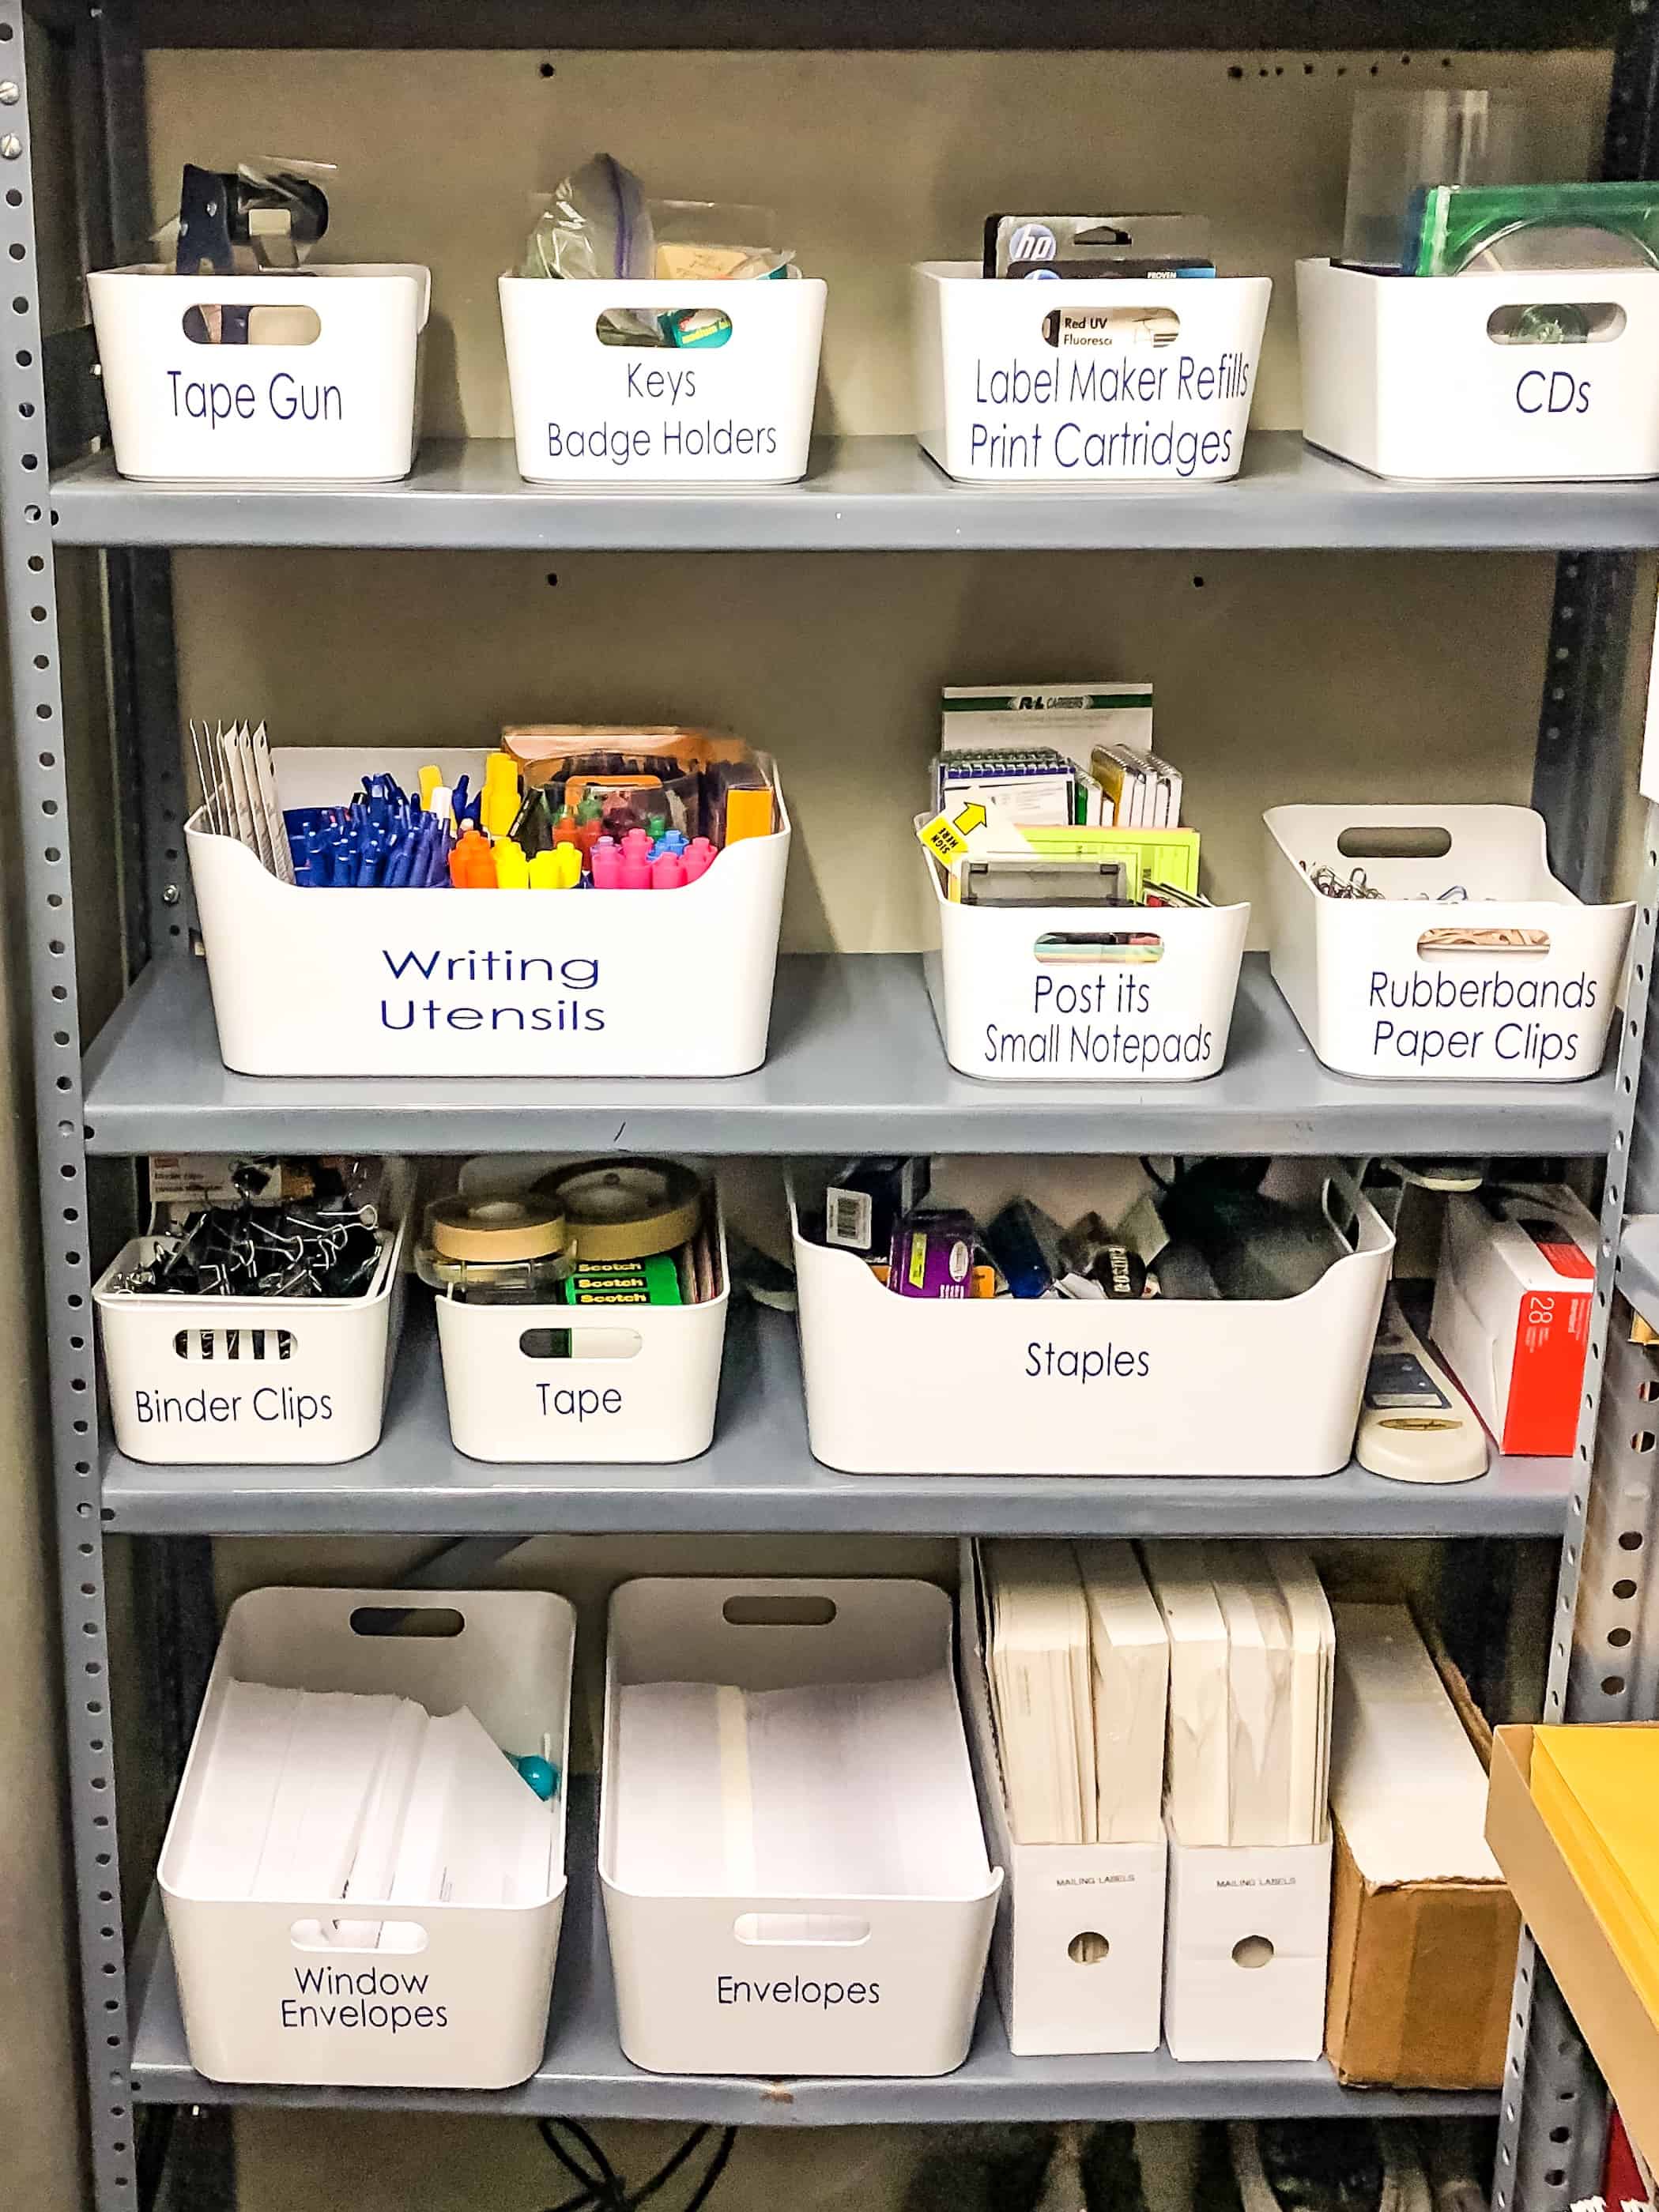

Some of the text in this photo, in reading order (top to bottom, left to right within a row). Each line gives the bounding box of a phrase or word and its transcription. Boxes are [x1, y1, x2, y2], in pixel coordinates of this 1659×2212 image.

[1015, 226, 1052, 261] hp
[1064, 318, 1108, 330] Red UV
[628, 364, 695, 405] Keys
[977, 352, 1250, 404] Label Maker Refills
[1517, 371, 1590, 413] CDs
[167, 371, 341, 430] Tape Gun
[549, 420, 775, 465] Badge Holders
[972, 420, 1234, 477] Print Cartridges
[931, 834, 950, 854] SIGN
[938, 827, 960, 848] HERE
[383, 950, 598, 989] Writing
[1035, 974, 1149, 1013] Post its
[1371, 970, 1597, 1008] Rubberbands
[382, 1000, 605, 1031] Utensils
[985, 1024, 1213, 1072] Small Notepads
[1374, 1021, 1578, 1068] Paper Clips
[578, 1278, 643, 1288] Scotch
[579, 1262, 642, 1272] Scotch
[580, 1294, 647, 1303] Scotch
[1529, 1296, 1555, 1324] 28
[1026, 1343, 1148, 1384] Staples
[136, 1387, 332, 1428] Binder Clips
[536, 1384, 621, 1423] Tape
[1056, 1875, 1136, 1886] MAILING LABELS
[1216, 1877, 1296, 1887] MAILING LABELS
[295, 1966, 428, 1995] Window
[718, 1976, 879, 2010] Envelopes
[282, 1999, 447, 2033] Envelopes
